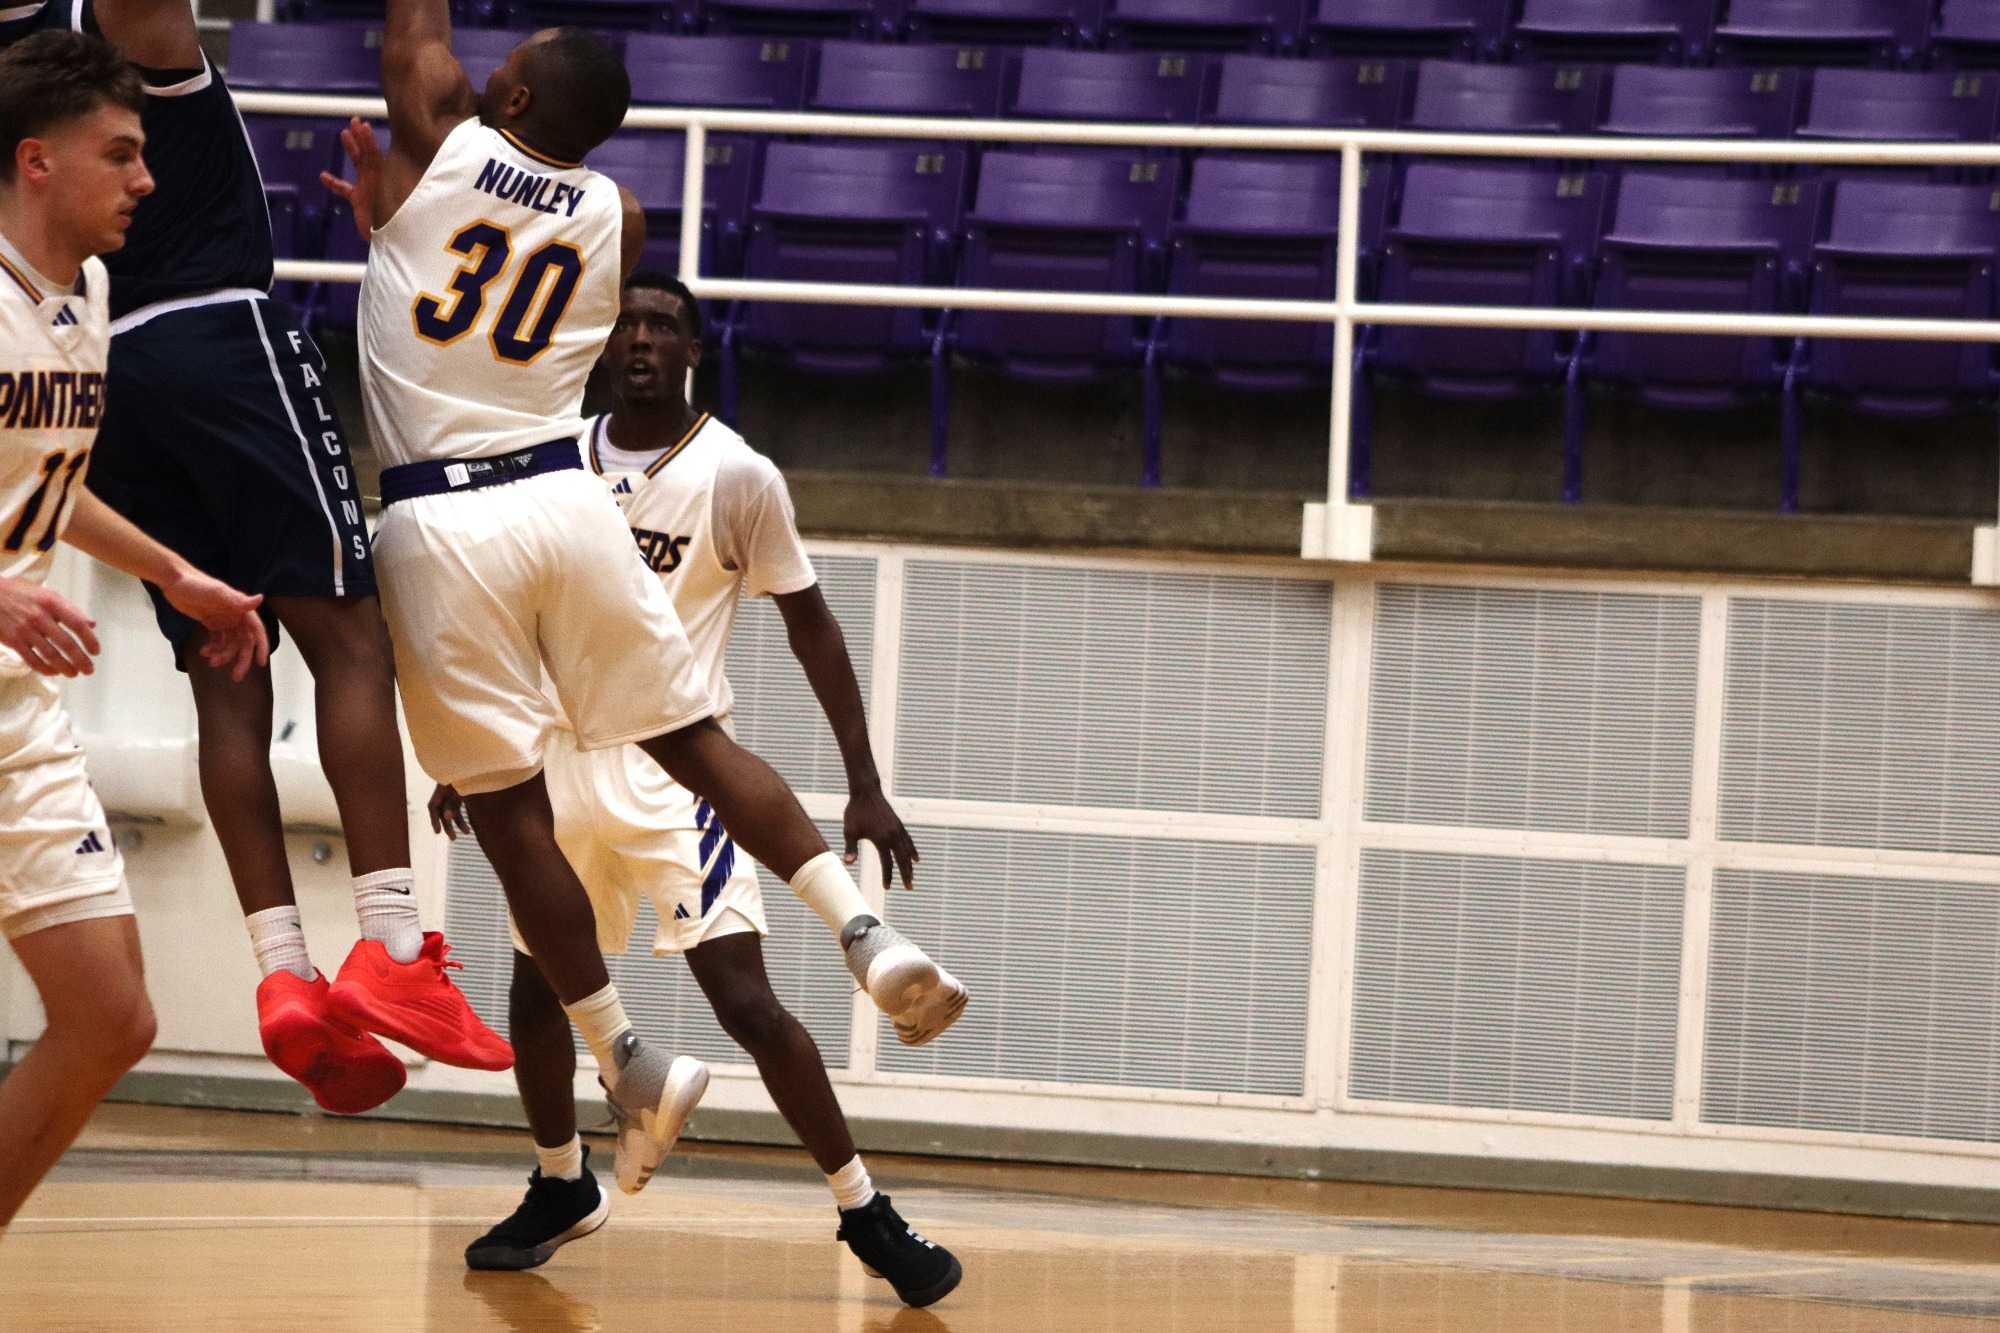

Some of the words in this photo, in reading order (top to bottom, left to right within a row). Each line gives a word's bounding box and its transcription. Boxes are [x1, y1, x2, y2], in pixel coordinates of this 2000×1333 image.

[474, 158, 586, 217] NUNLEY
[411, 217, 586, 367] 30
[2, 448, 89, 556] 11
[286, 330, 366, 560] FALCONS
